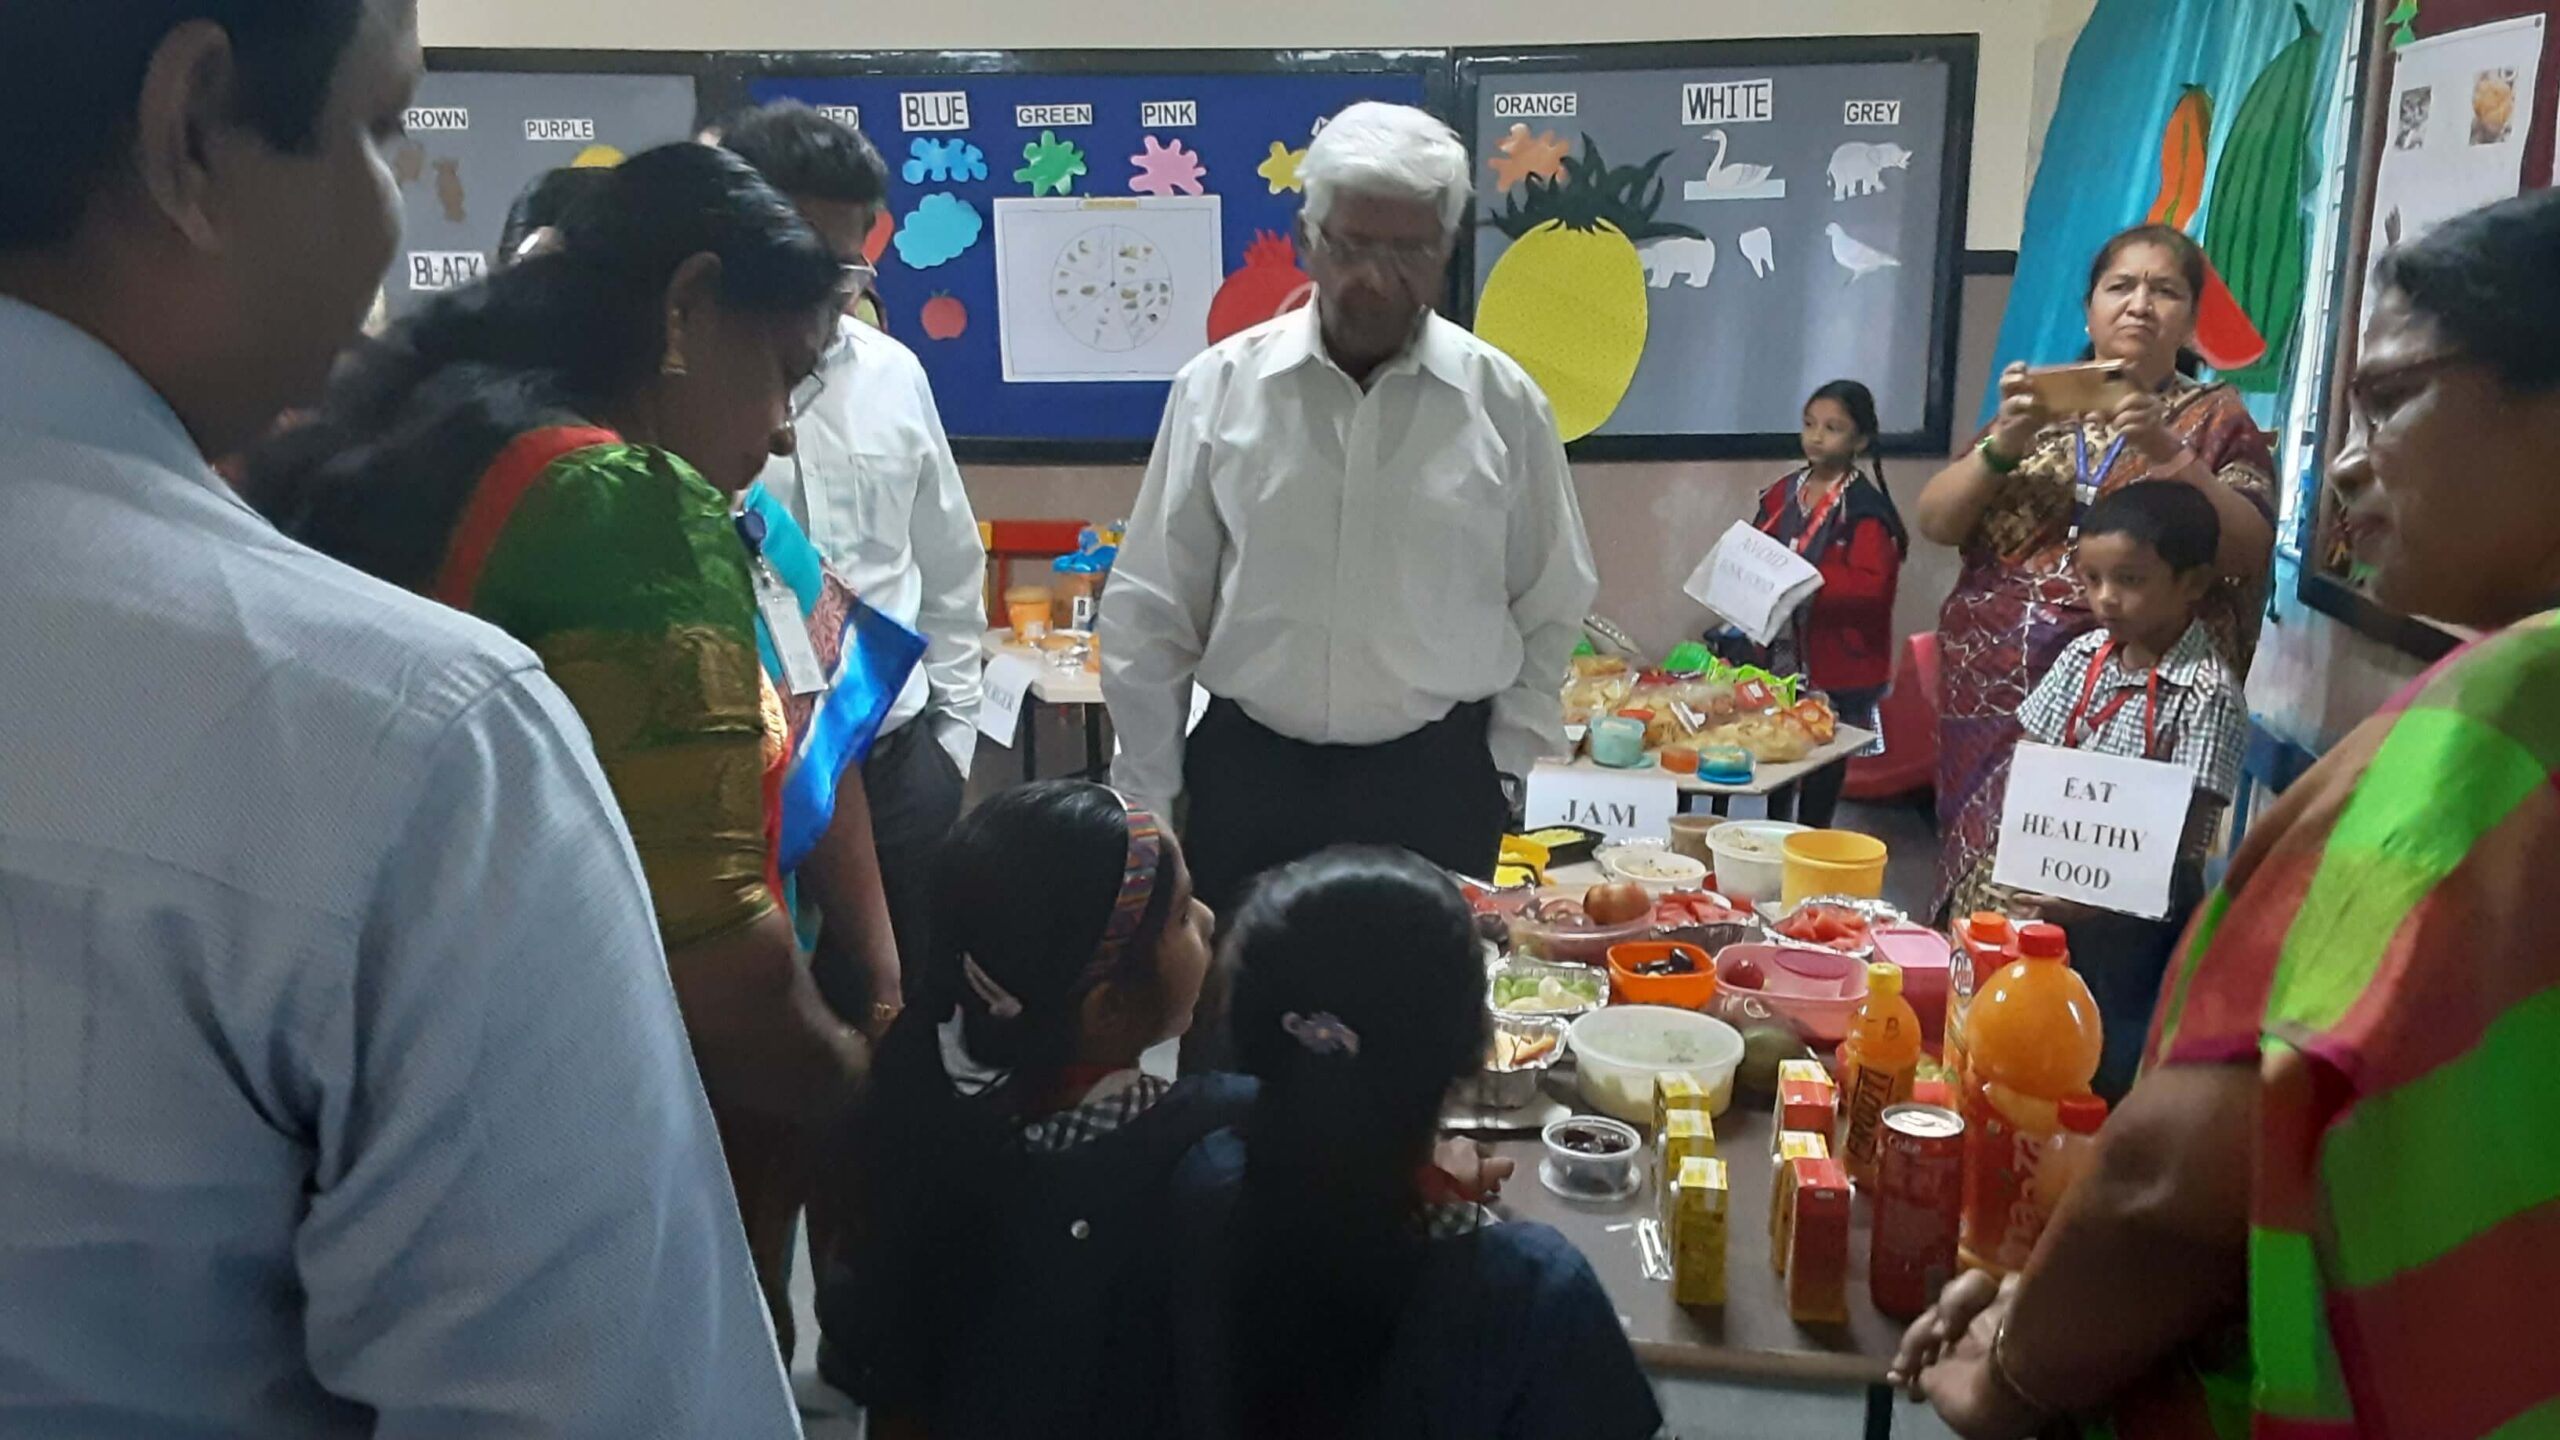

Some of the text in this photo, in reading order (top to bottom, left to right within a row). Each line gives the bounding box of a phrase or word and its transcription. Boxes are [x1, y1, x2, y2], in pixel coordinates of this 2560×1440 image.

[905, 95, 965, 127] BLUE
[1143, 103, 1193, 125] PINK
[1496, 95, 1575, 115] ORANGE
[1687, 83, 1769, 121] WHITE
[1846, 102, 1899, 123] GREY
[406, 110, 467, 128] ROWN
[1018, 107, 1091, 124] GREEN
[527, 121, 592, 138] PURPLE
[2063, 776, 2118, 804] EAT
[1561, 799, 1637, 829] JAM
[2021, 812, 2149, 853] HEALTHY
[2040, 856, 2112, 891] FOOD
